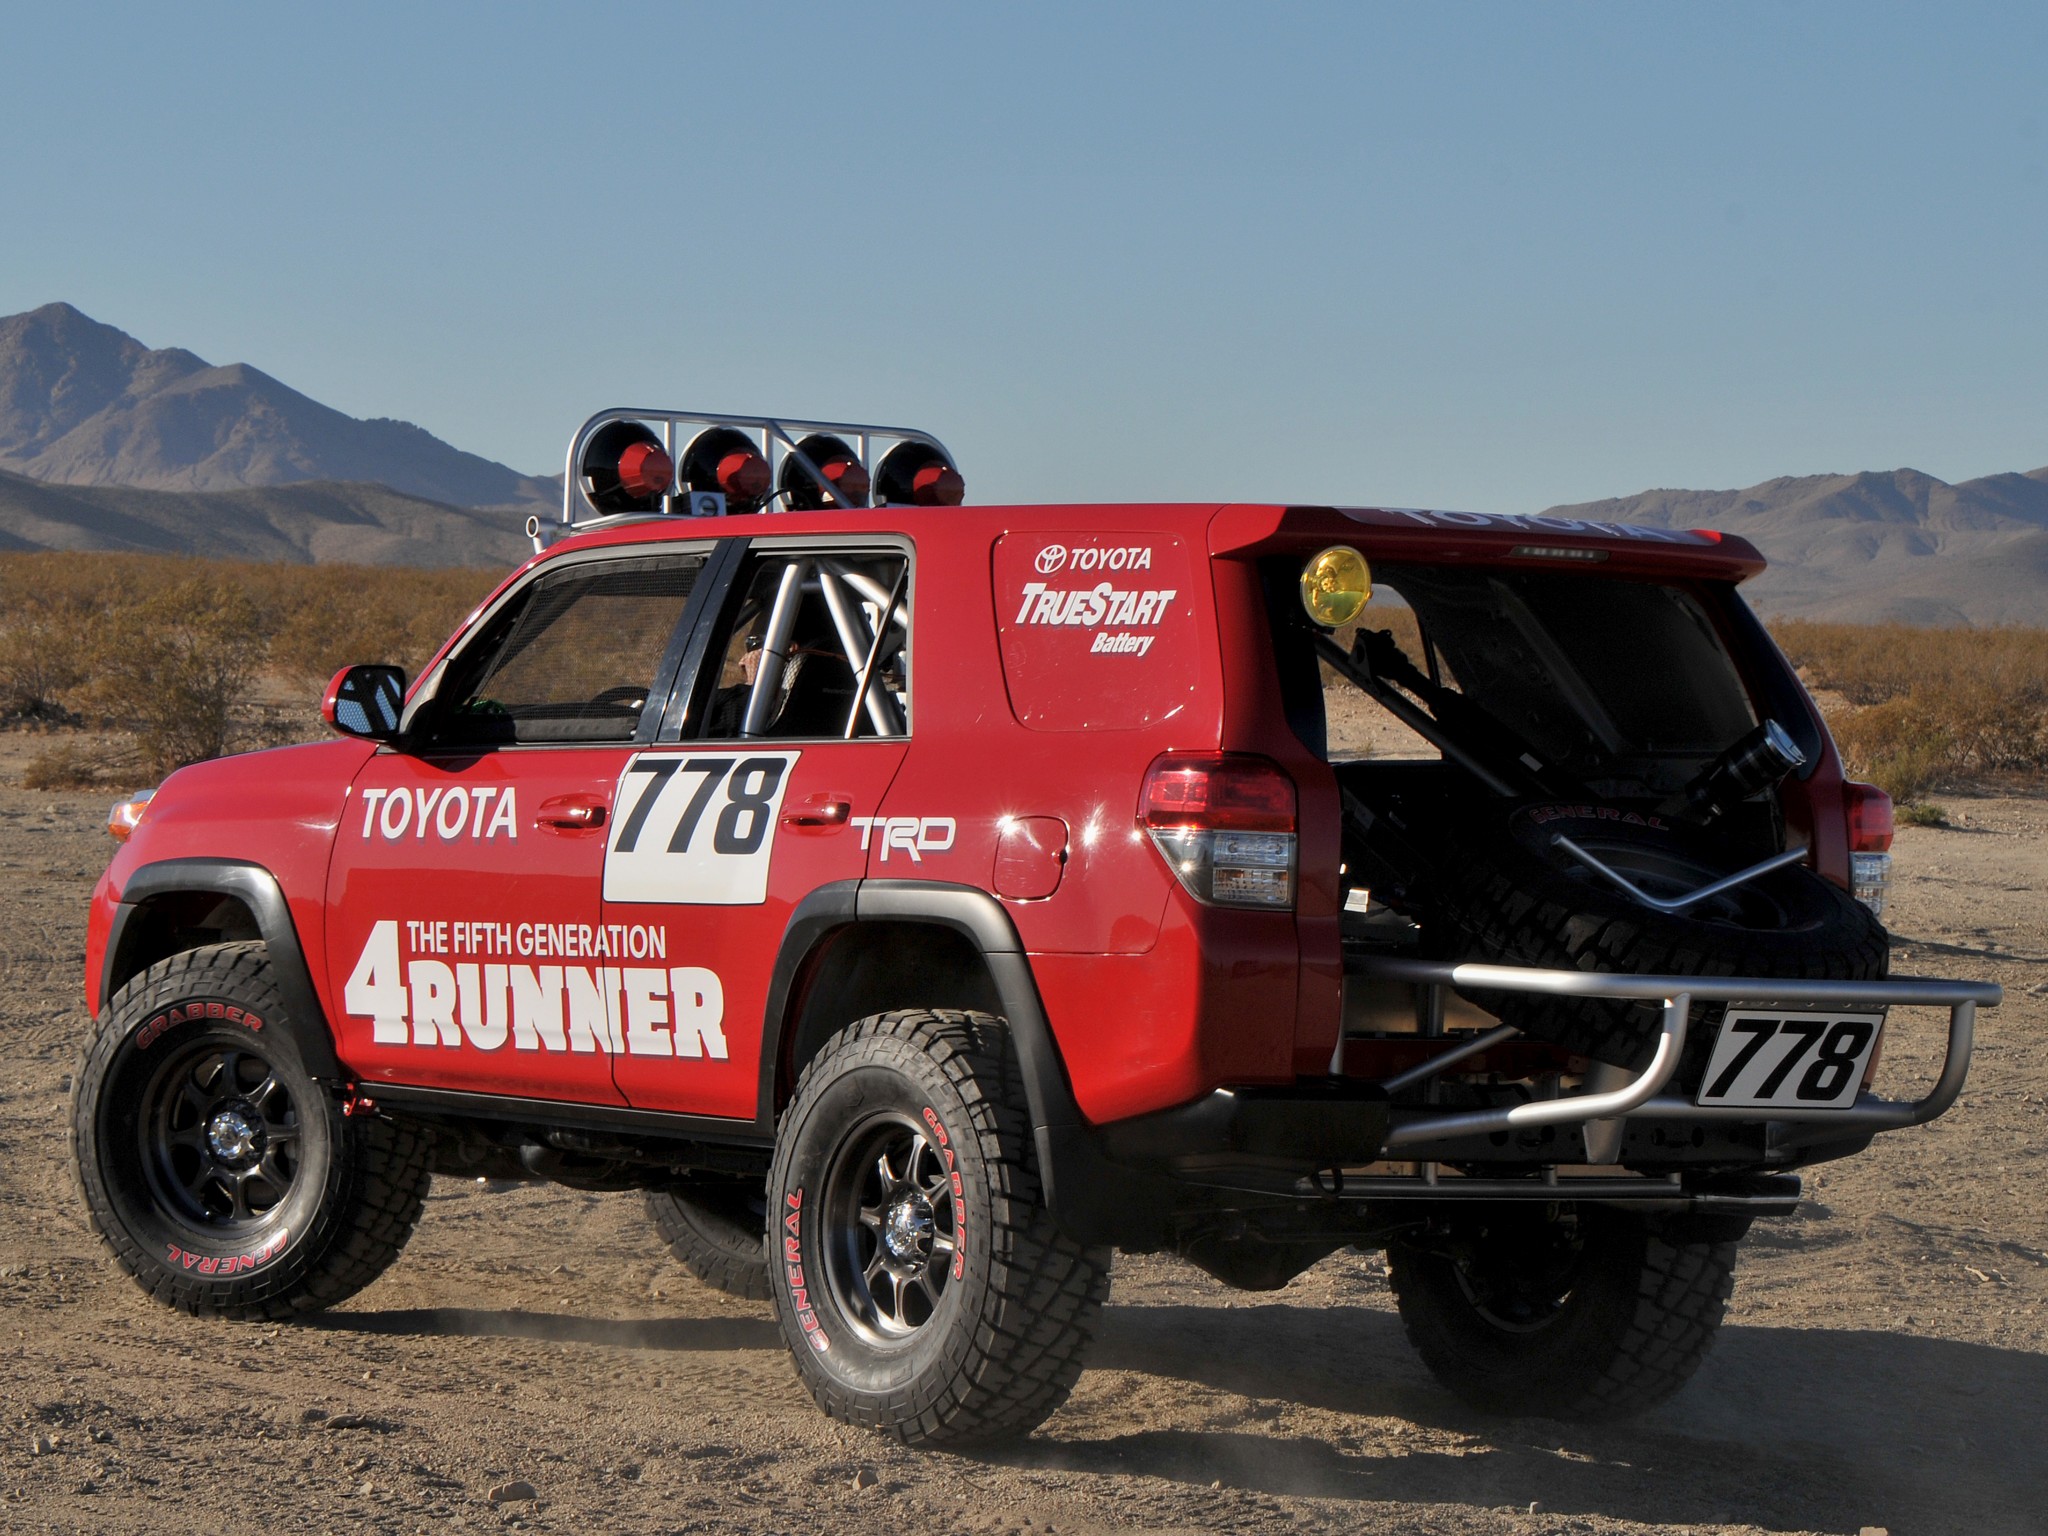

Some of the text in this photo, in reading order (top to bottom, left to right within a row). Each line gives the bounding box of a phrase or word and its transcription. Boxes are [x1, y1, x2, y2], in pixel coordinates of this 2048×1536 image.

[1379, 508, 1676, 542] TOYOTA
[1069, 547, 1152, 570] TOYOTA
[1089, 631, 1156, 657] Battery
[361, 786, 518, 840] TOYOTA
[612, 757, 788, 855] 778
[1529, 805, 1670, 832] GENERAL
[850, 816, 957, 863] TRD
[406, 920, 667, 959] THE FIFTH GENERATION
[344, 919, 729, 1059] 4RUNNER
[136, 1001, 264, 1049] GRABBER
[1705, 1018, 1870, 1101] 778
[922, 1106, 968, 1282] GRABBER
[166, 1226, 291, 1276] GENERAL
[781, 1187, 830, 1354] GENERAL
